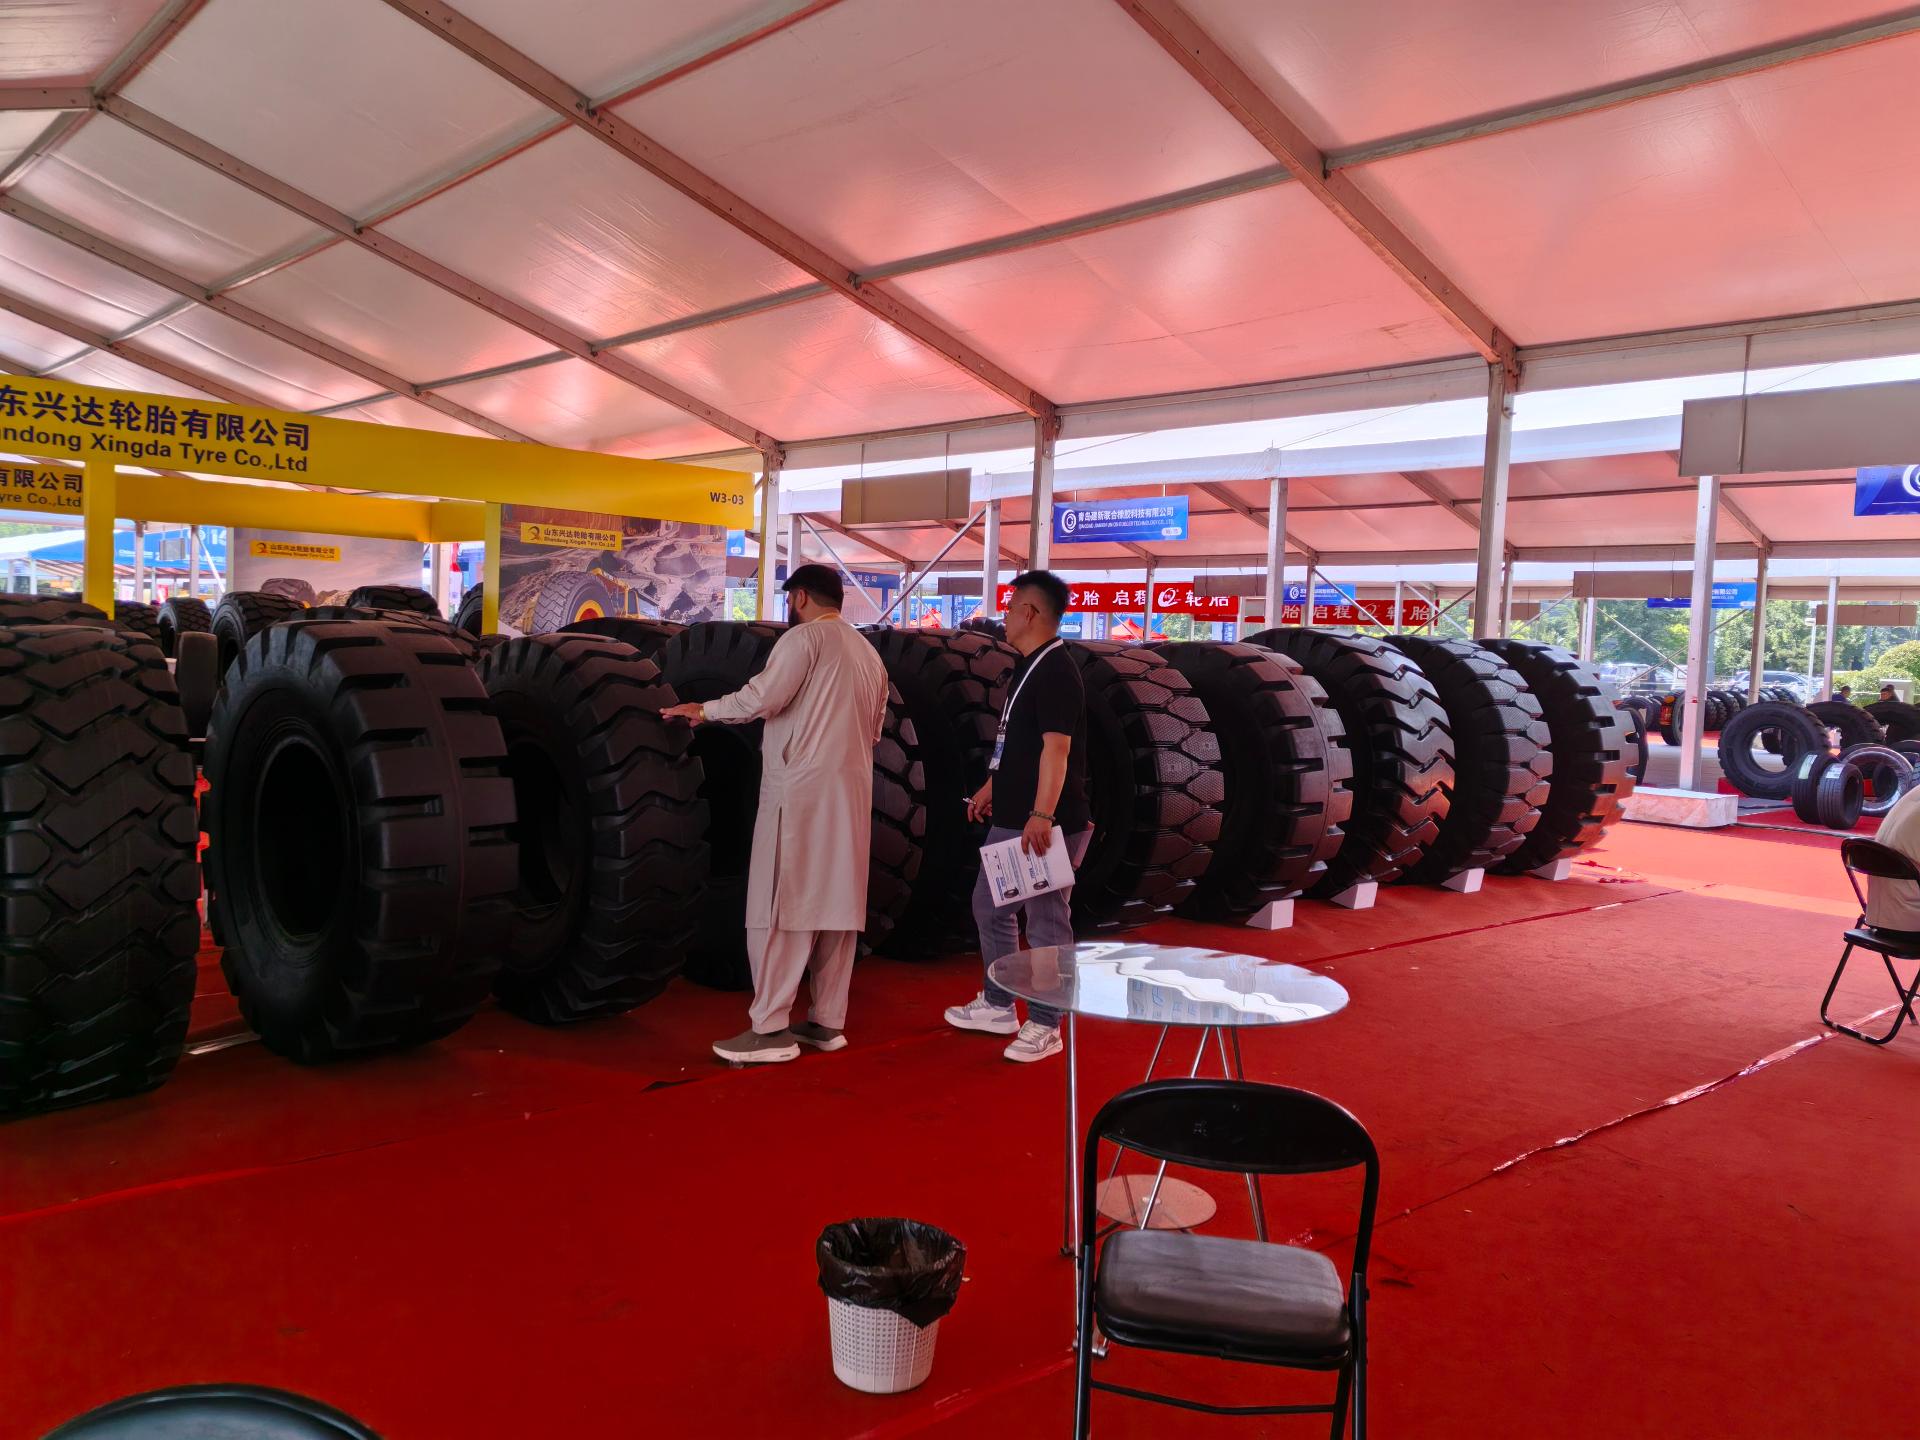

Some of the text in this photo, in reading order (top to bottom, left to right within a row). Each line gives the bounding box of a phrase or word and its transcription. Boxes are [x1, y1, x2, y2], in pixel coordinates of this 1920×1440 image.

[0, 385, 309, 451] 东兴达轮胎有限公司
[0, 426, 307, 472] ndong Xingda Tyre Co.,Ltd
[710, 492, 744, 505] W3-03
